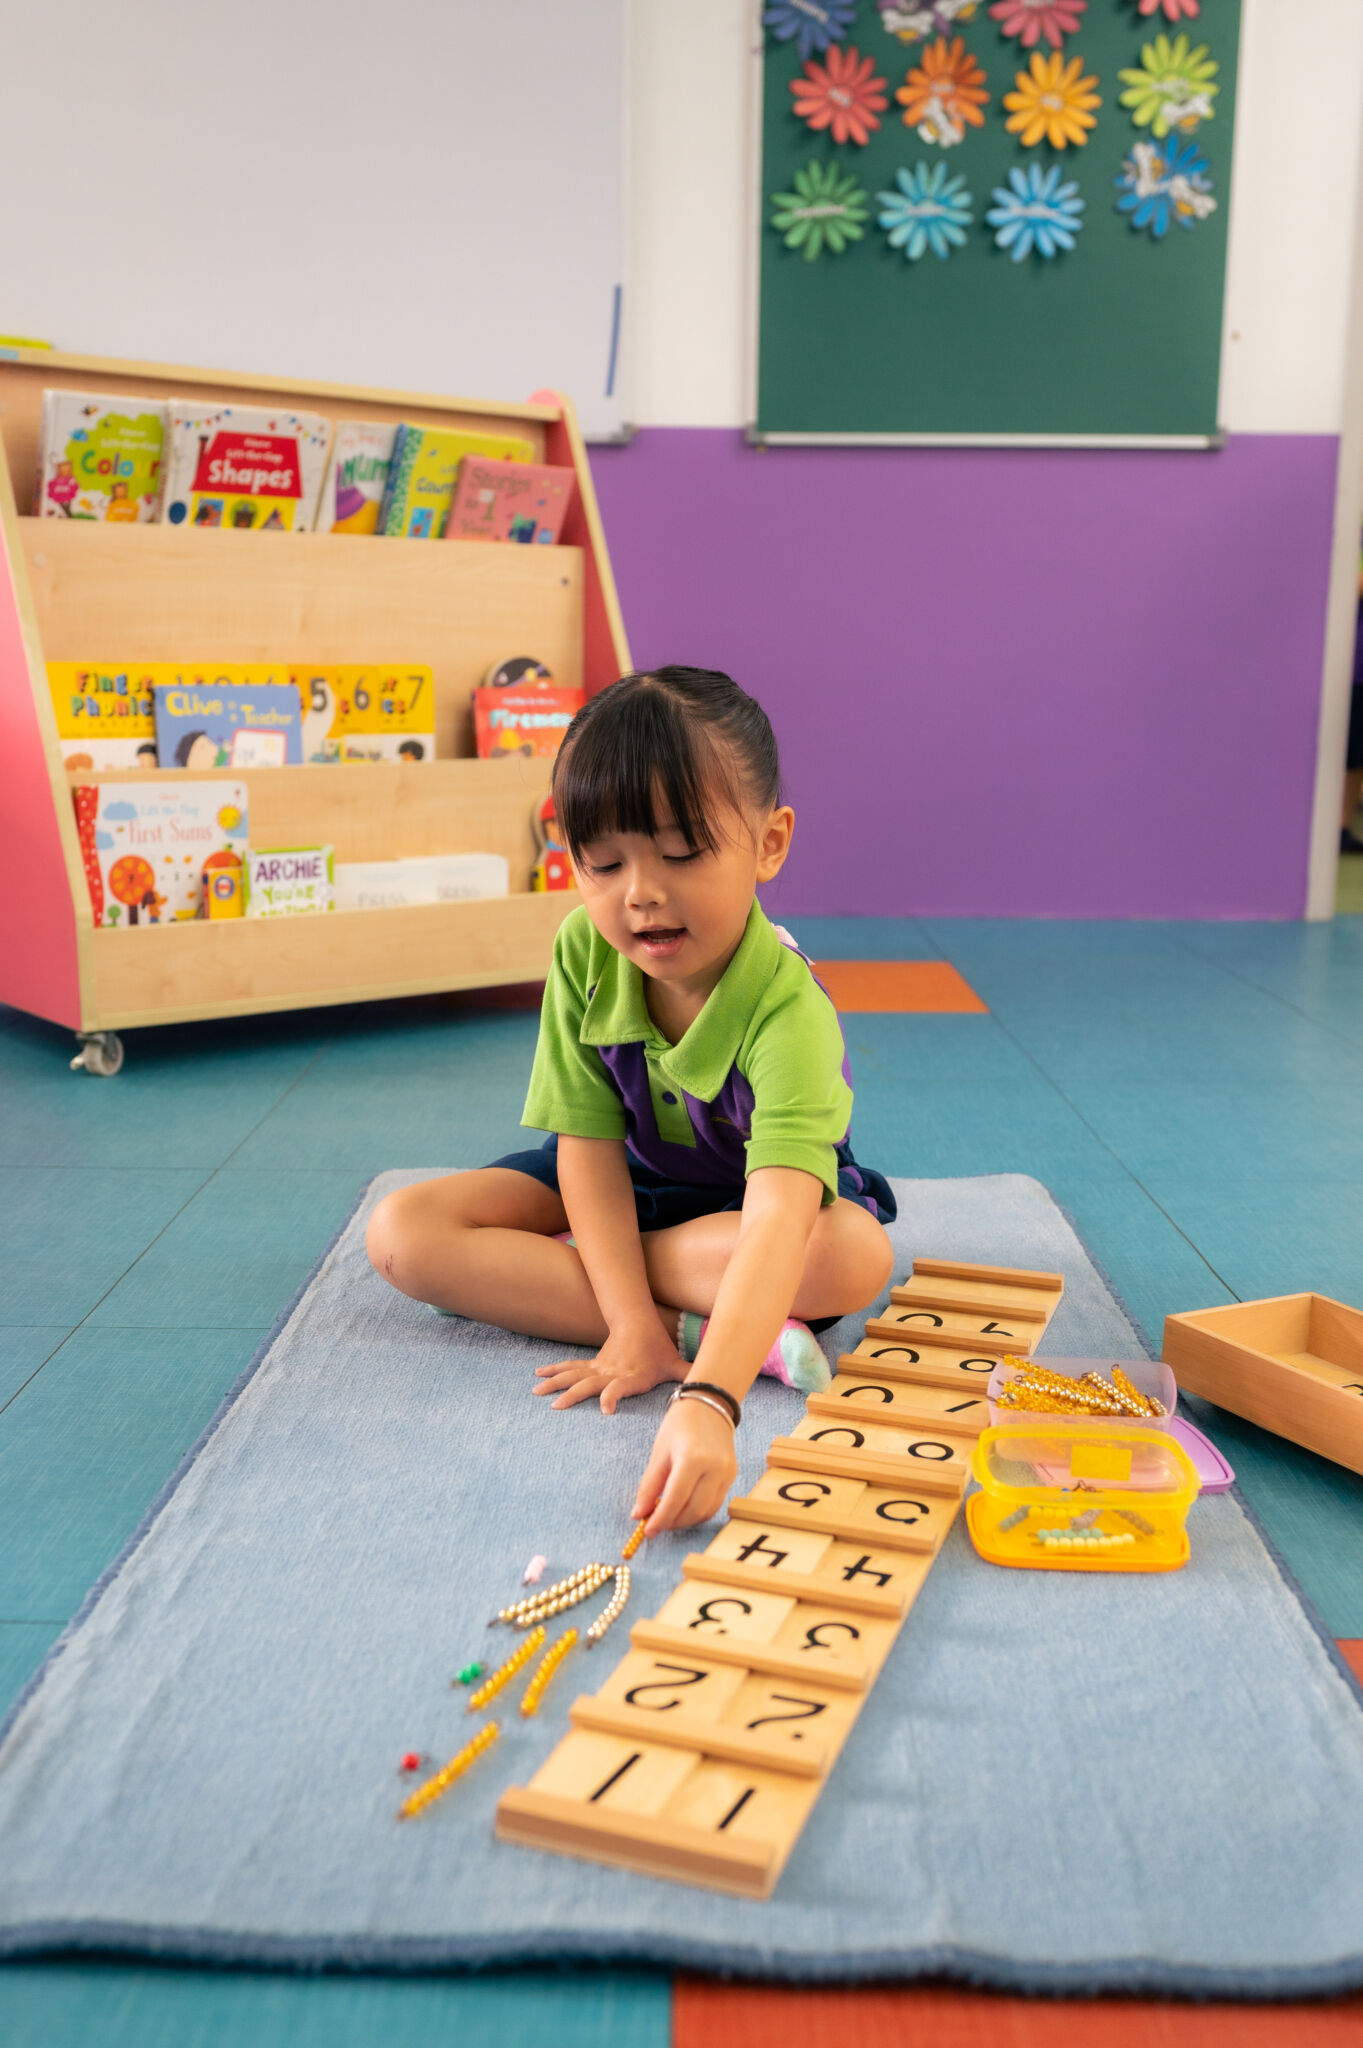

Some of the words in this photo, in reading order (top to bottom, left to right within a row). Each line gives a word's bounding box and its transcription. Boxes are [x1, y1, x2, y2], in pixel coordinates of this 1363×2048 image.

[207, 459, 294, 494] Shapes
[165, 691, 223, 716] Clive
[309, 677, 328, 714] 5
[354, 676, 370, 712] 6
[408, 675, 424, 710] 7
[129, 818, 163, 844] First
[169, 817, 212, 843] Sums
[255, 856, 321, 882] ARCHIE
[735, 1534, 789, 1568] 4
[842, 1555, 893, 1588] 4
[624, 1662, 709, 1711] 2
